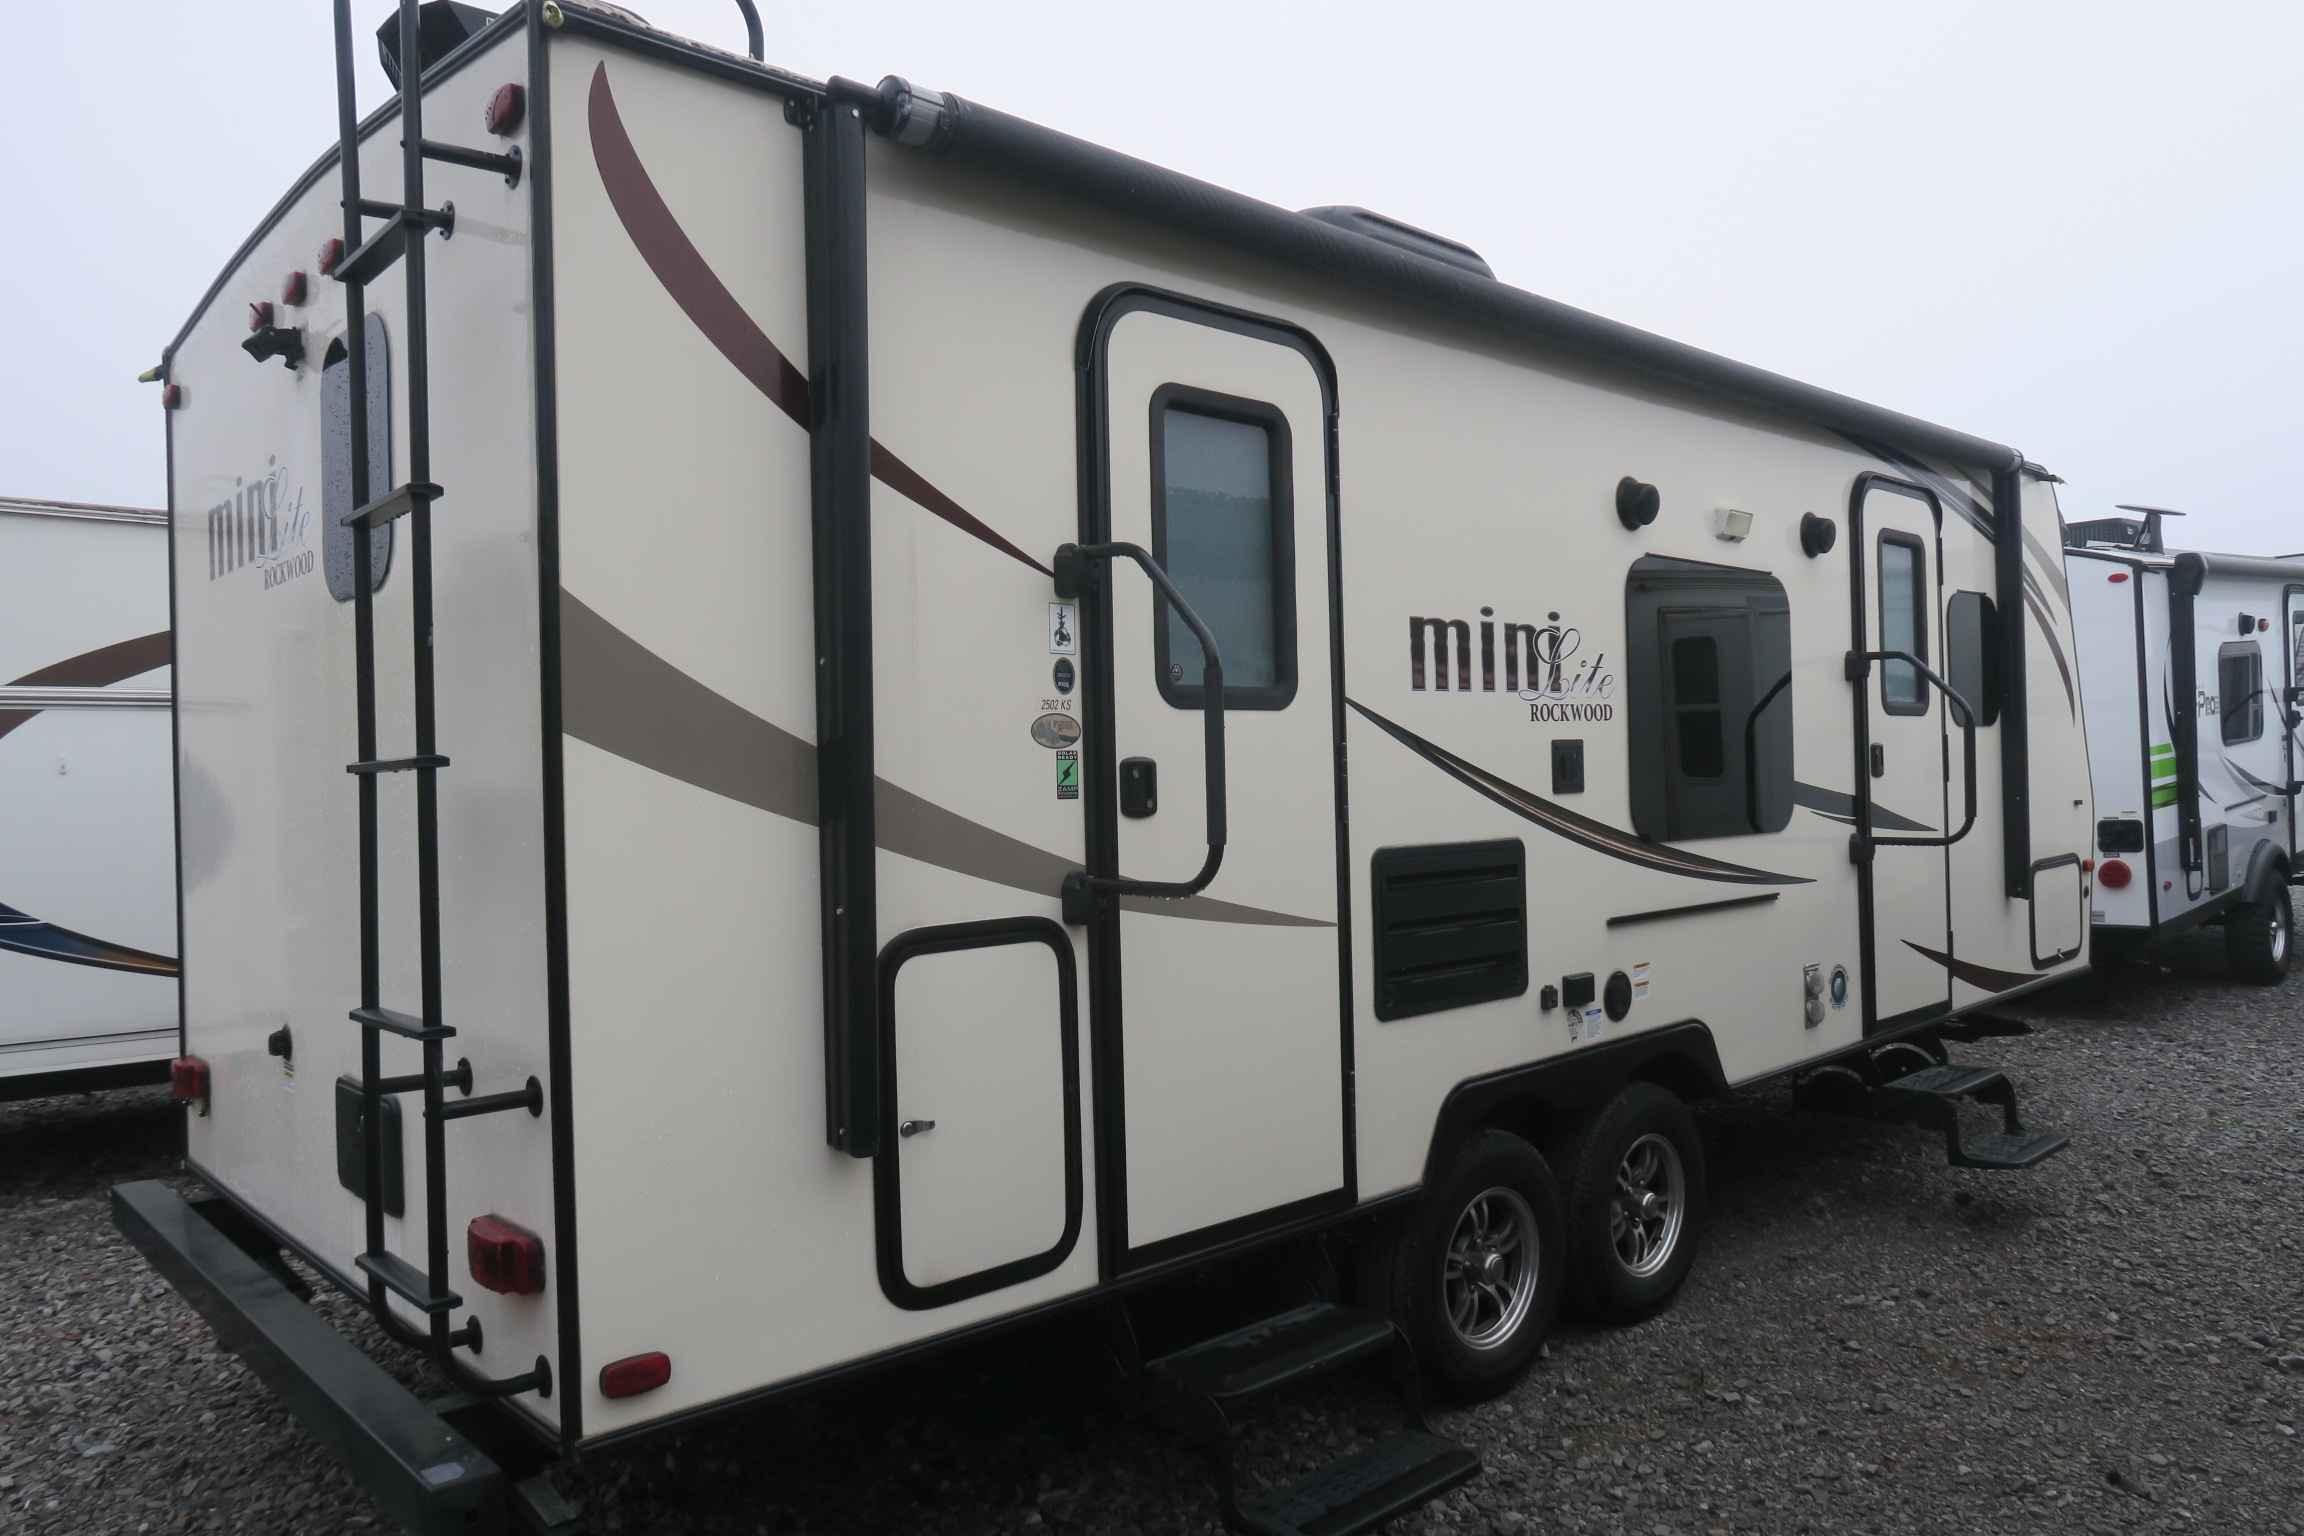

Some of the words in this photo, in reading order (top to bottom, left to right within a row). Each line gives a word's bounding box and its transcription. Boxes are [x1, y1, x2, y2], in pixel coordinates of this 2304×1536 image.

[208, 454, 278, 581] mini
[264, 550, 314, 591] ROCKWOOD
[1409, 605, 1562, 693] mini
[1518, 627, 1615, 701] Lite
[1041, 698, 1059, 711] 2502
[1060, 698, 1072, 711] KS
[1530, 703, 1613, 722] ROCKWOOD
